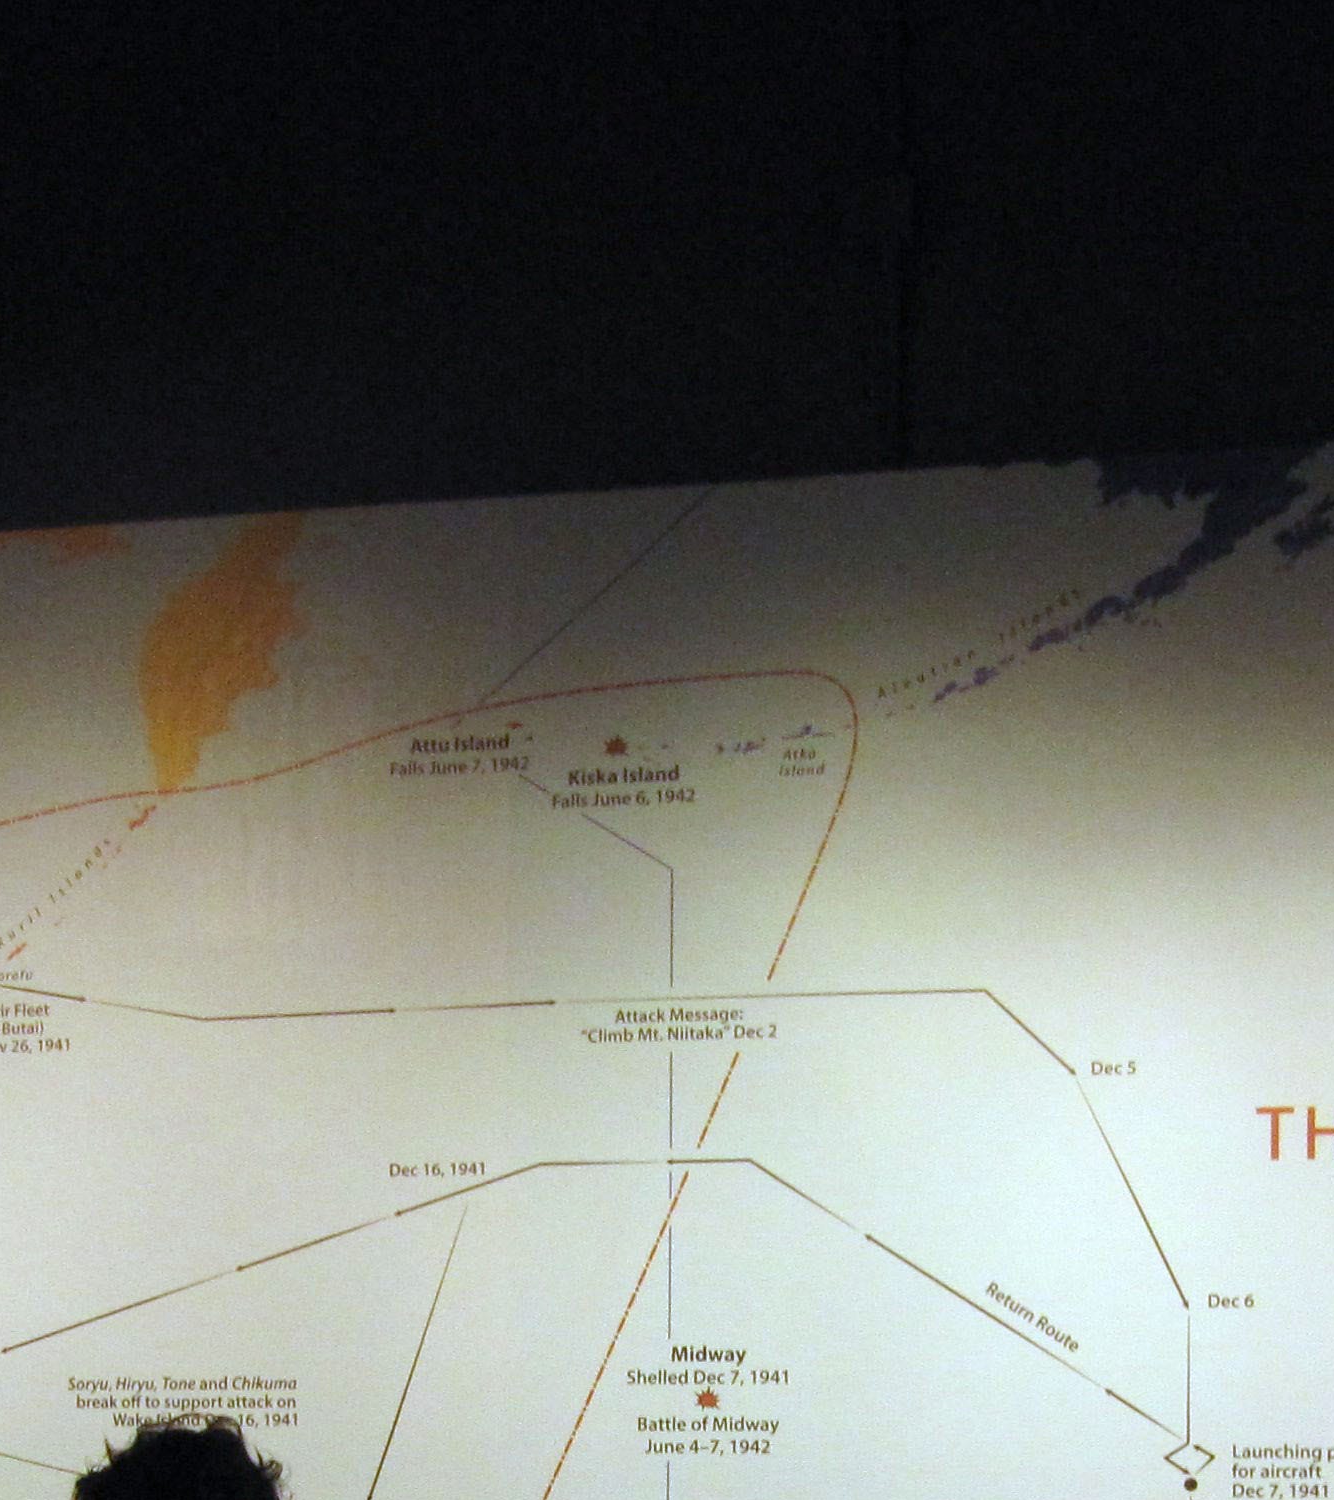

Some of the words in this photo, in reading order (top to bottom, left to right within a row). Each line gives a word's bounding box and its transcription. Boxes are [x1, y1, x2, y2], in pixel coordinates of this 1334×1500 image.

[567, 767, 618, 787] Kiska
[622, 763, 681, 785] Island
[550, 791, 589, 810] Falls
[592, 791, 632, 808] June
[634, 789, 651, 807] 6,
[656, 786, 696, 805] 1942
[13, 1002, 50, 1018] Fleet
[614, 1007, 666, 1024] Attack
[669, 1007, 744, 1026] Message:
[1, 1021, 45, 1036] Butai)
[637, 1025, 664, 1043] Mt.
[733, 1023, 764, 1040] Dec
[768, 1023, 778, 1040] 2
[11, 1038, 32, 1054] 26,
[37, 1037, 71, 1053] 1941
[1090, 1060, 1123, 1077] Dec
[1127, 1060, 1137, 1076] 5
[1207, 1293, 1240, 1309] Dec
[1243, 1293, 1255, 1309] 6
[671, 1345, 747, 1367] Midway
[626, 1368, 689, 1386] Shelled
[693, 1369, 725, 1387] Dec
[730, 1369, 744, 1387] 7,
[750, 1369, 789, 1385] 1941
[637, 1416, 687, 1432] Battle
[690, 1415, 709, 1432] of
[712, 1415, 780, 1436] Midway
[645, 1438, 686, 1455] June
[730, 1439, 771, 1455] 1942
[1232, 1443, 1323, 1464] Launching
[1231, 1462, 1256, 1479] for
[1259, 1462, 1322, 1480] aircraft
[1232, 1482, 1264, 1499] Dec
[1269, 1483, 1284, 1500] 7,
[1289, 1483, 1329, 1499] 1941
